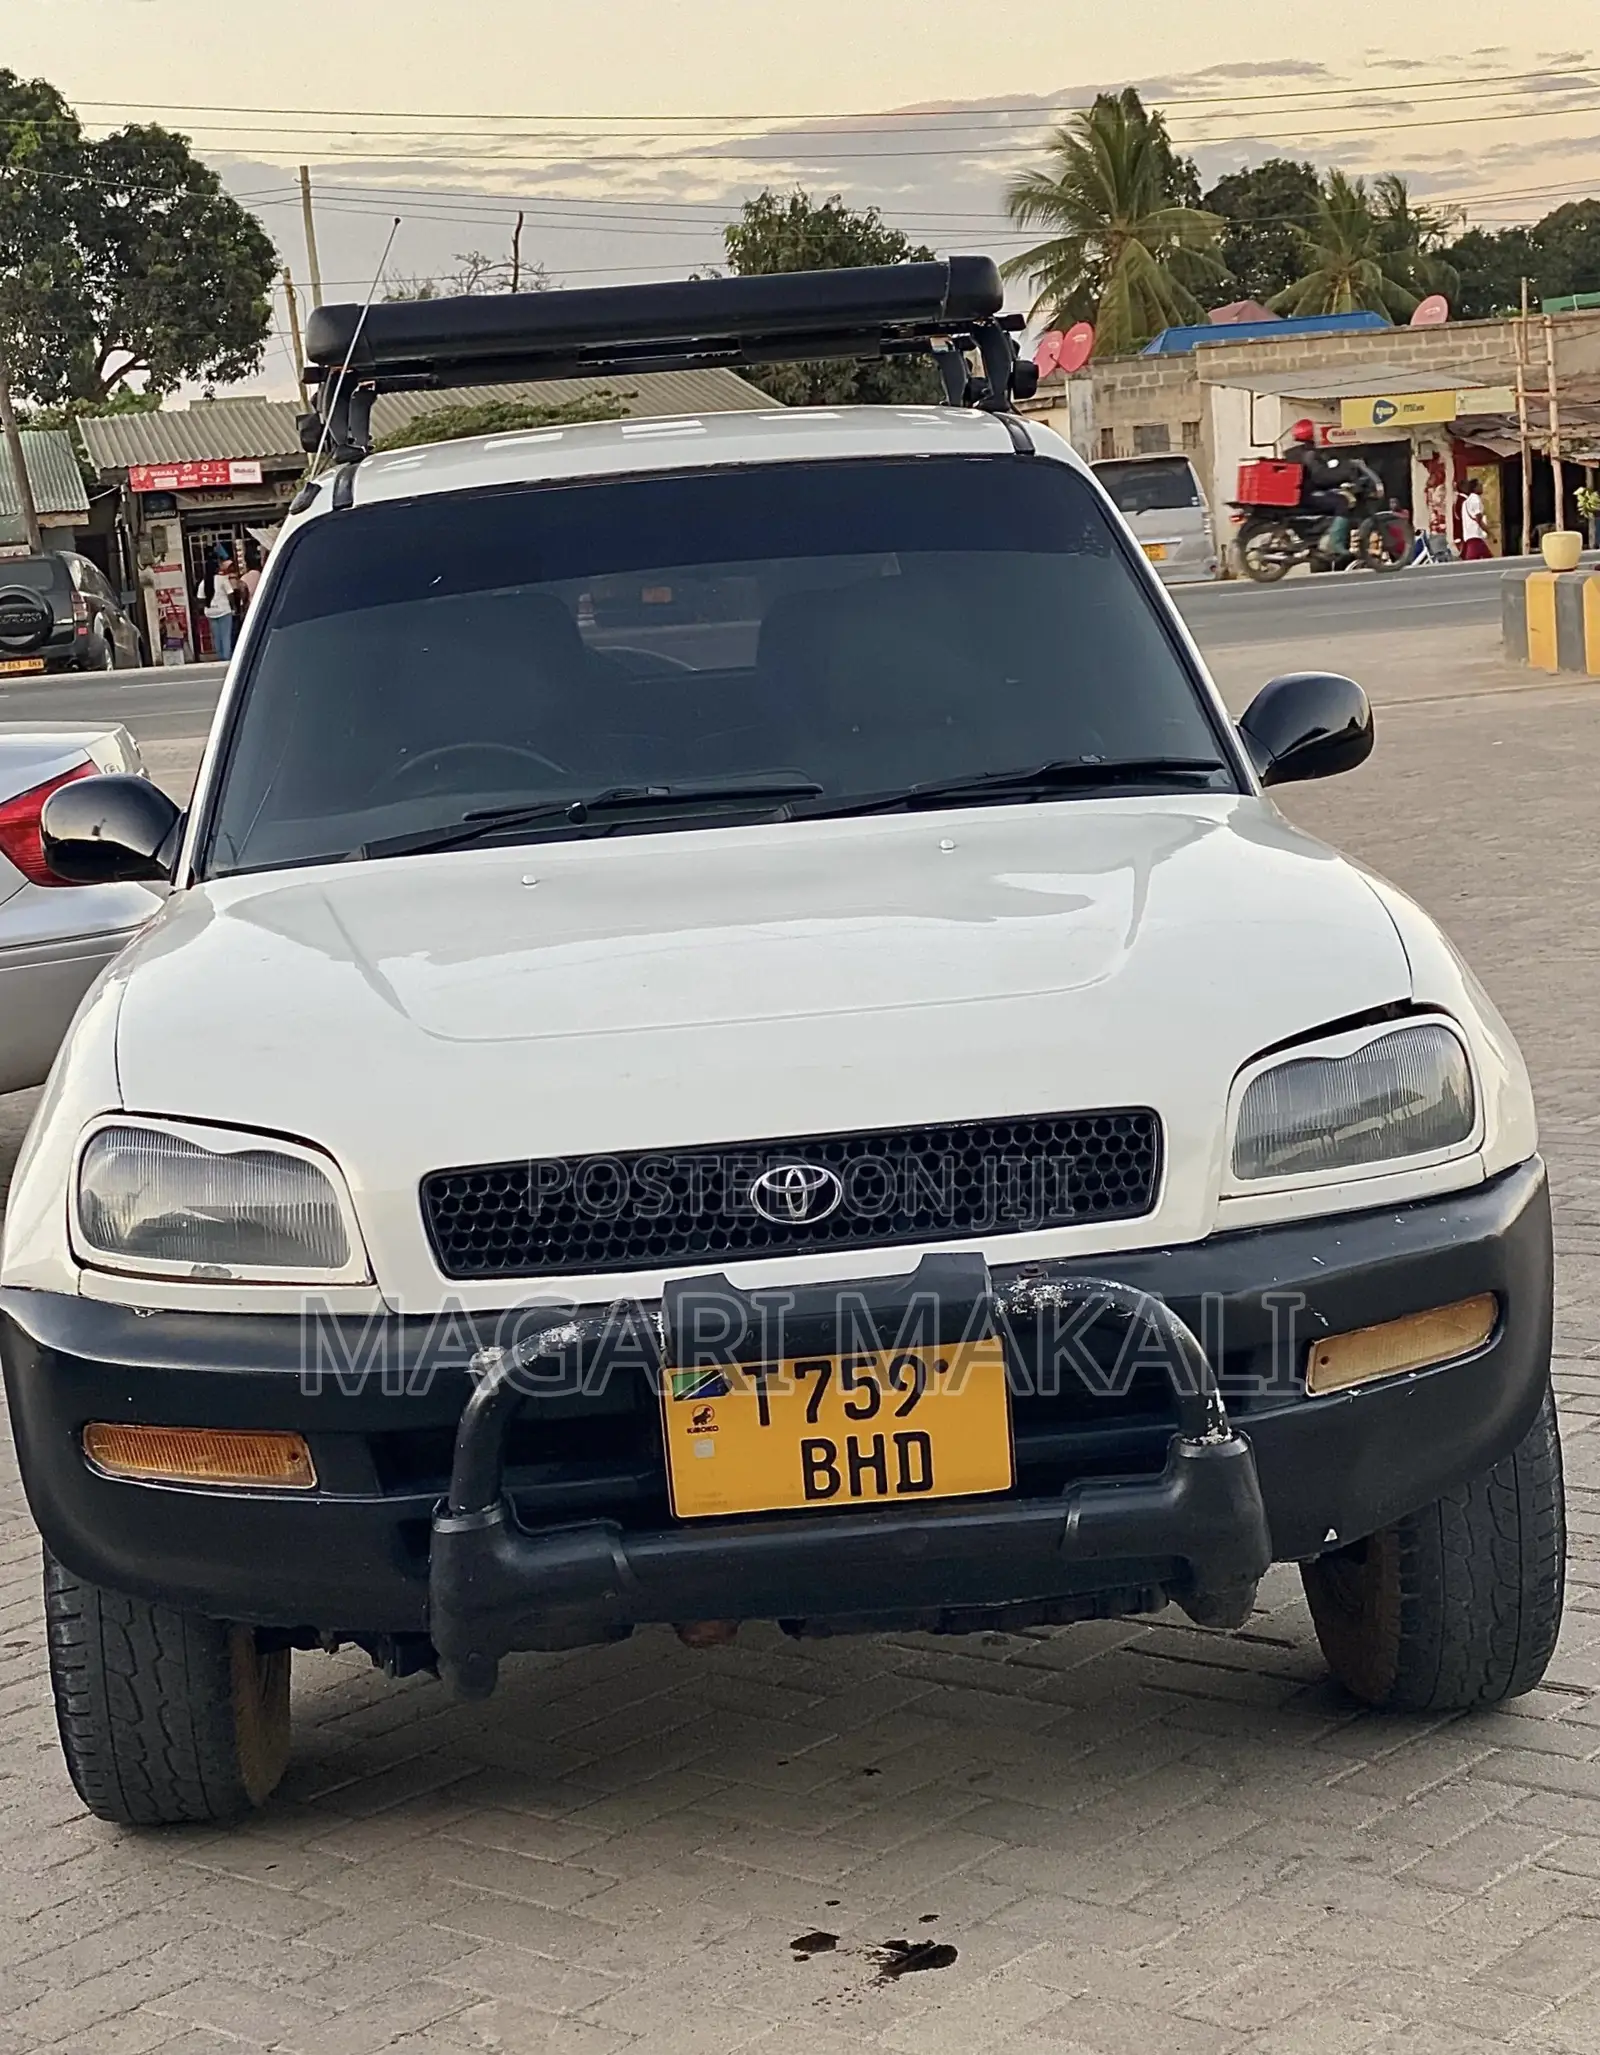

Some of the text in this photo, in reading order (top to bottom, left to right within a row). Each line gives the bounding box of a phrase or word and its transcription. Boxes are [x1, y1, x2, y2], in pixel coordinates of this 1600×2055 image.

[150, 469, 179, 477] WAKALA
[743, 1354, 928, 1426] T 759
[801, 1431, 934, 1501] BHD
